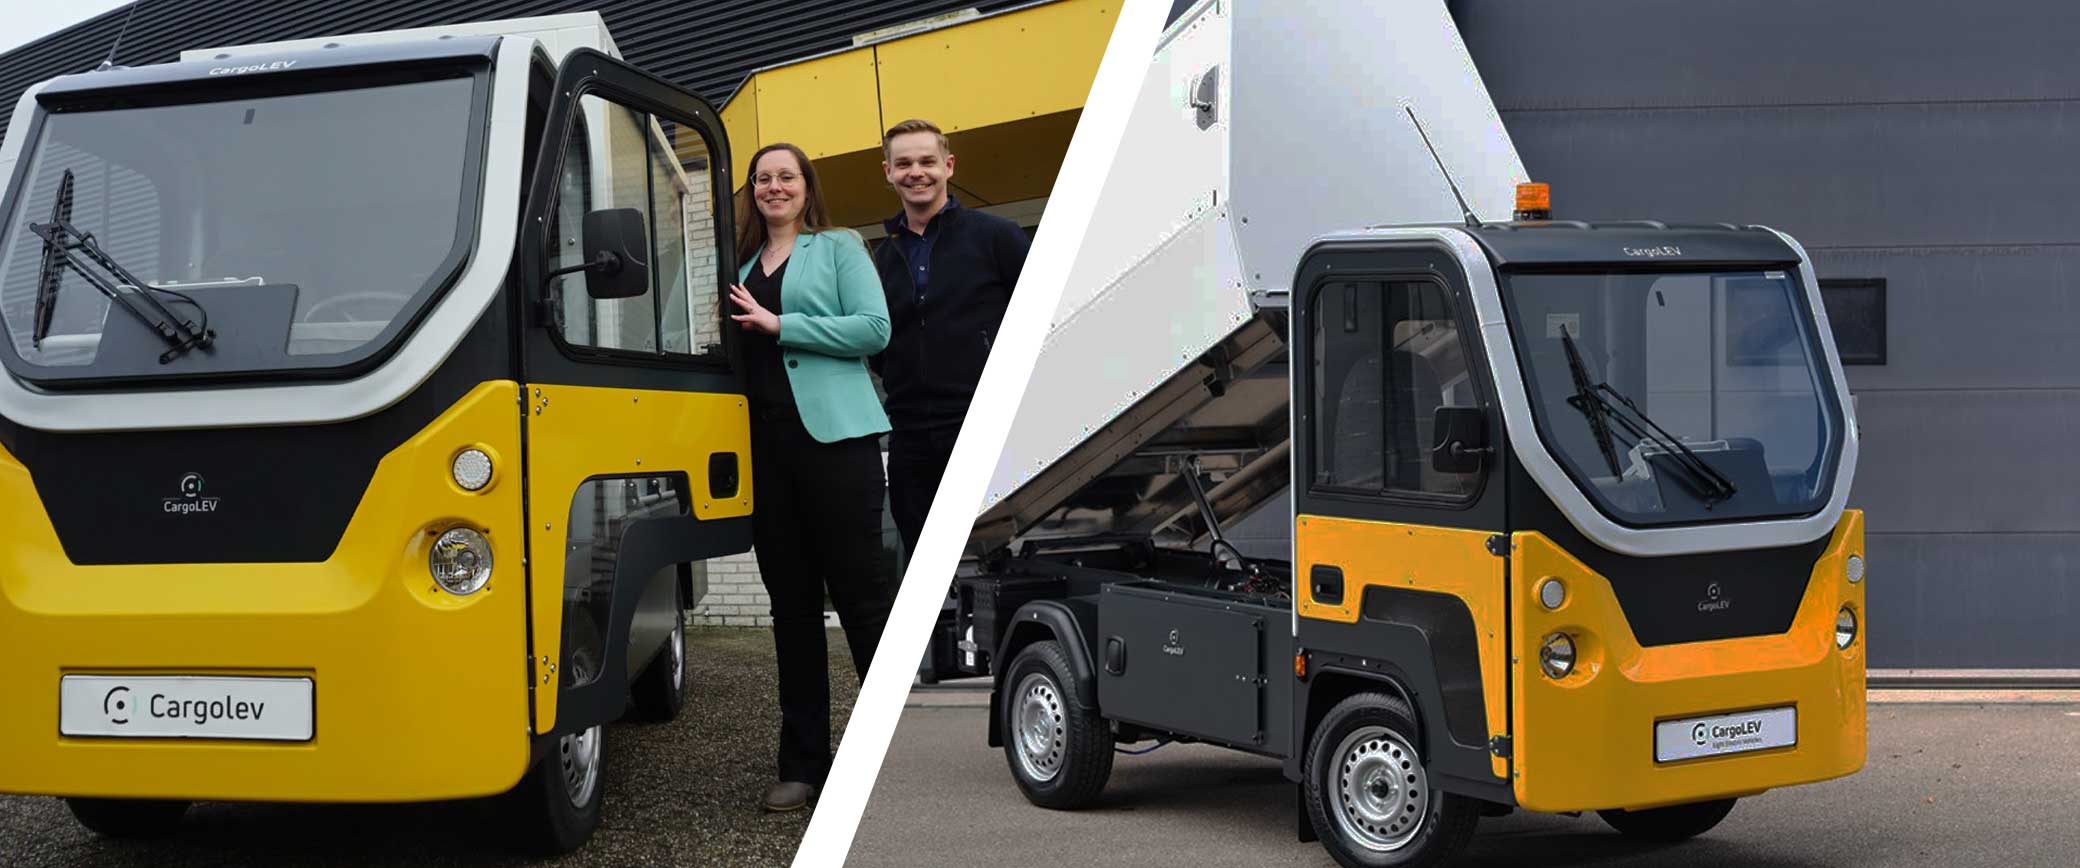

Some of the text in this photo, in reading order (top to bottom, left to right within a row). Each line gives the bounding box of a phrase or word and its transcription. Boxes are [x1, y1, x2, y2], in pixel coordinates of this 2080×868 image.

[209, 60, 297, 75] CargoLEV
[1623, 246, 1681, 257] CargoLEV
[164, 500, 218, 514] CargoLEV
[150, 693, 264, 725] Cargolev
[1712, 720, 1761, 738] CargoLEV
